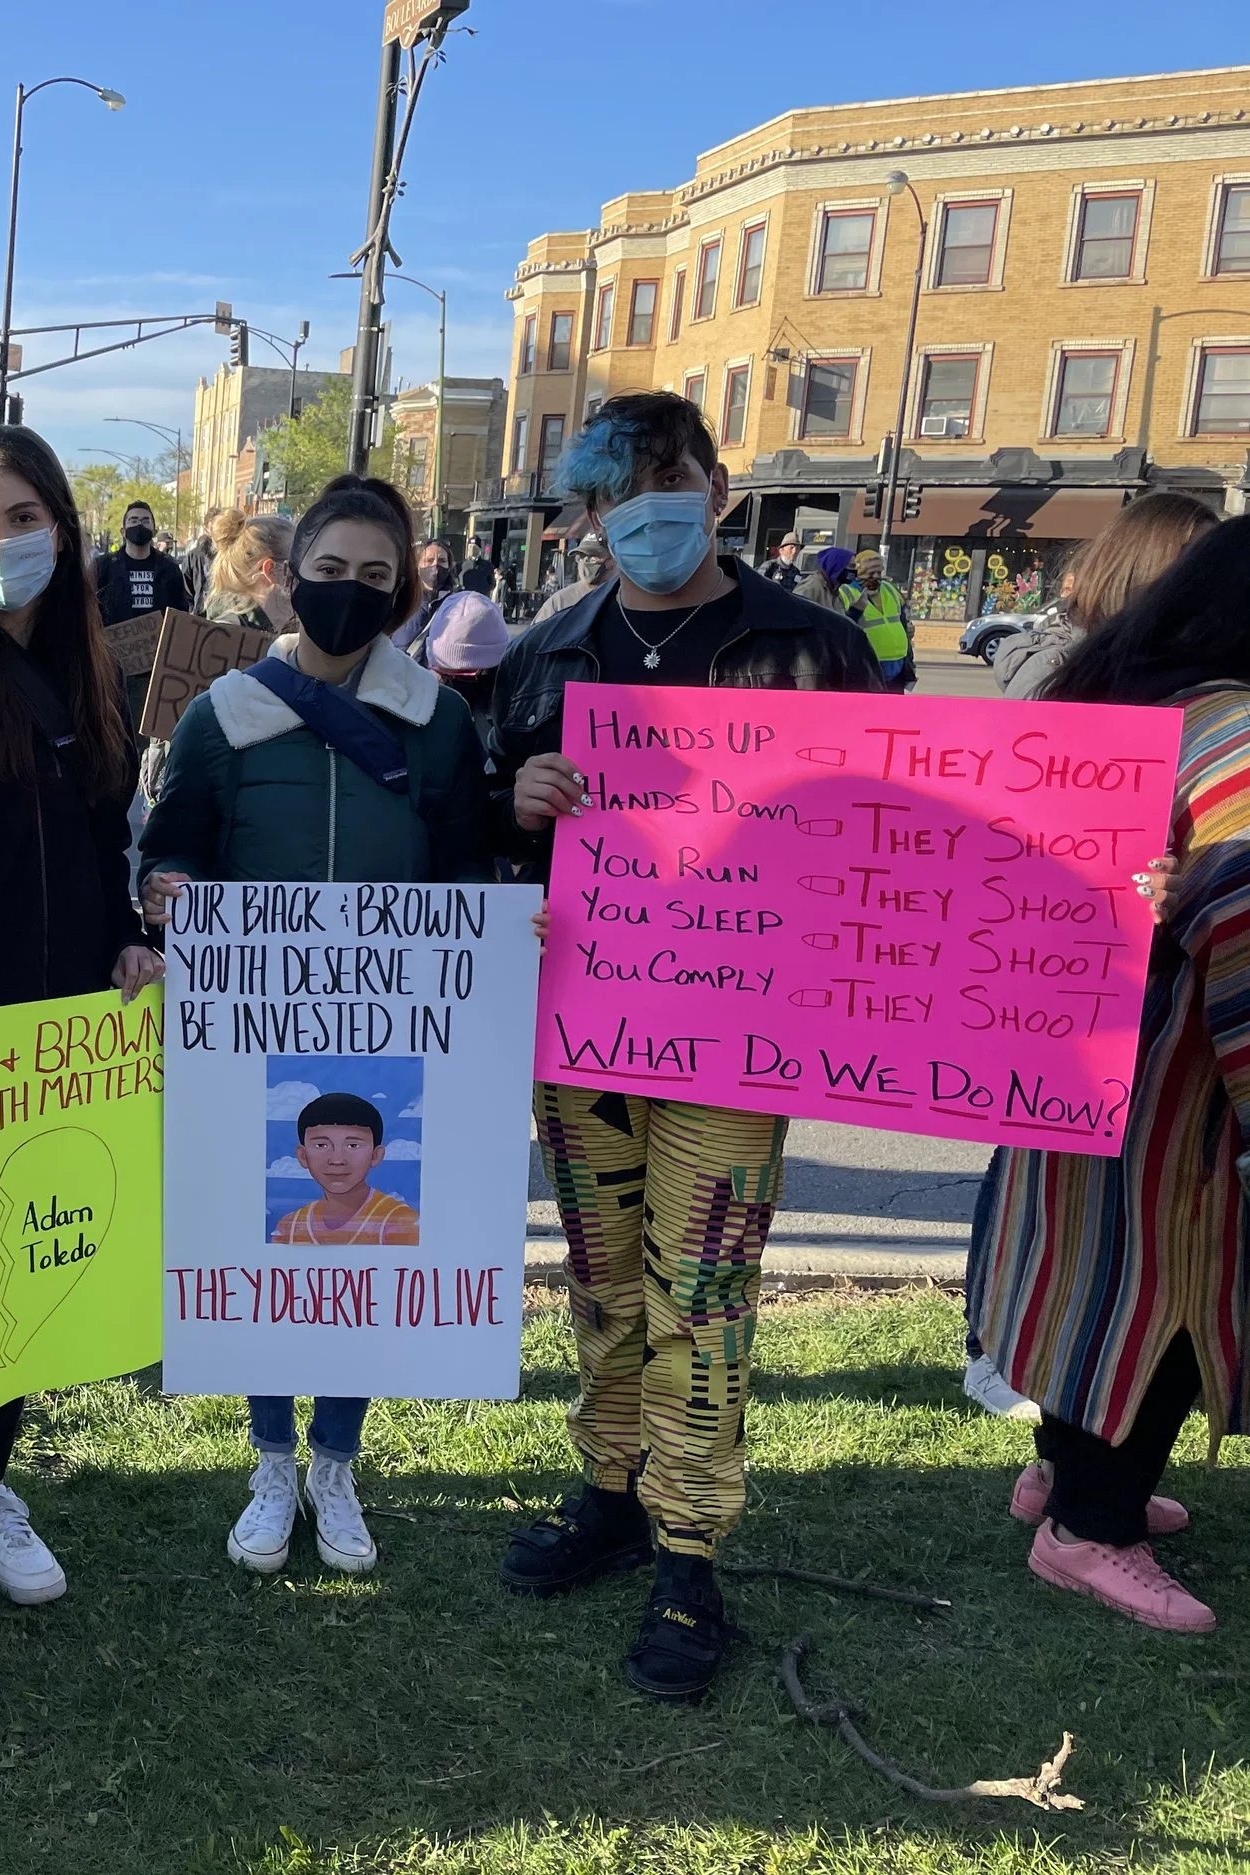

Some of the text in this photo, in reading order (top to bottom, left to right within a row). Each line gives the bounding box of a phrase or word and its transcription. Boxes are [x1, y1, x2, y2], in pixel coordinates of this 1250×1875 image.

[727, 722, 775, 753] UP
[865, 728, 994, 786] THEY
[1005, 731, 1166, 793] SHOOT
[852, 802, 966, 860] THEY
[983, 816, 1146, 866] SHOOT
[172, 882, 230, 936] OUR
[357, 884, 486, 940] BROWN
[849, 866, 954, 922] THEY
[978, 875, 1127, 929] SHOOT
[666, 900, 784, 935] SLEEP
[840, 921, 942, 967] THEY
[968, 928, 1129, 980] SHOOT
[172, 943, 473, 1000] YOUTH DESERVE TO
[34, 1002, 165, 1074] BROWN
[180, 1000, 452, 1054] BE INVESTED IN
[830, 978, 933, 1023] THEY
[959, 984, 1120, 1038] SHOOT
[554, 1012, 721, 1074] WHAT
[39, 1053, 165, 1116] MATTERS
[22, 1195, 93, 1236] Adam
[20, 1232, 97, 1274] Toledo
[166, 1267, 504, 1328] THEY DESERVE TO LIVE
